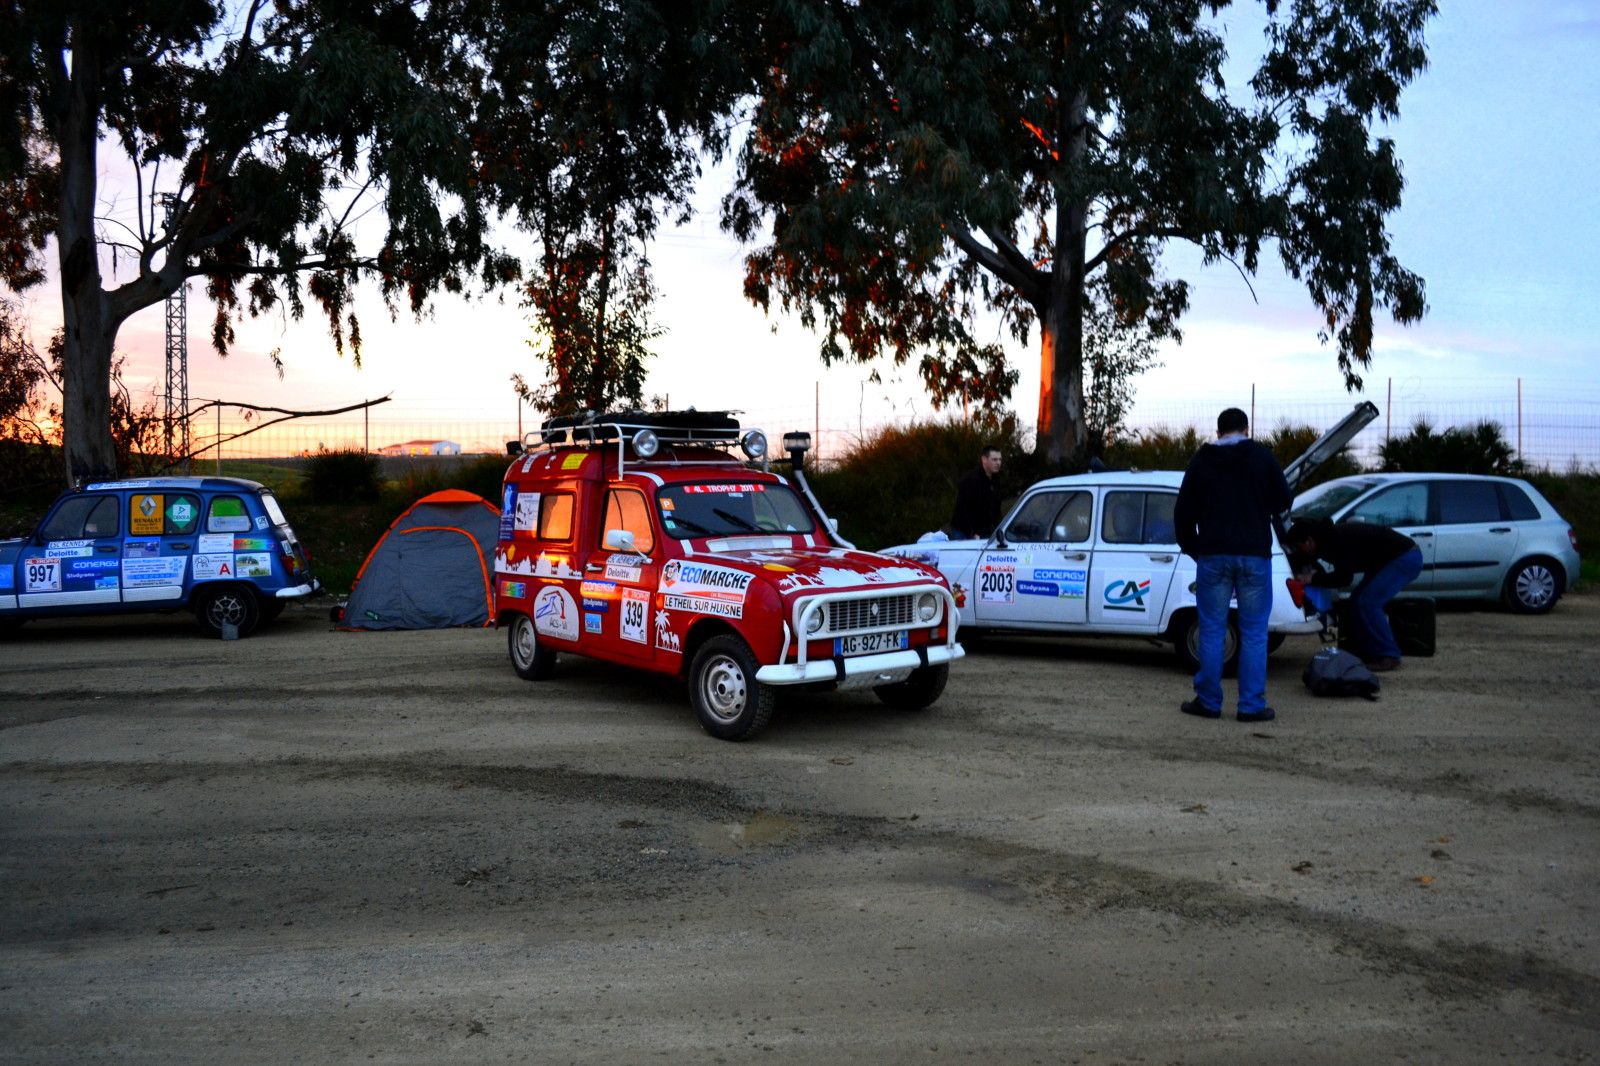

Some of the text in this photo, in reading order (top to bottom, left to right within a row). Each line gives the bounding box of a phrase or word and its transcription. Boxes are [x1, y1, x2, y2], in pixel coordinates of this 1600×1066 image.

[707, 485, 736, 493] TROPHY
[740, 484, 755, 492] 2011
[29, 565, 54, 582] 997
[219, 563, 231, 575] A
[981, 572, 1013, 593] 2003
[624, 600, 643, 628] 339
[665, 597, 741, 617] LE THEIL SUR HUISNE
